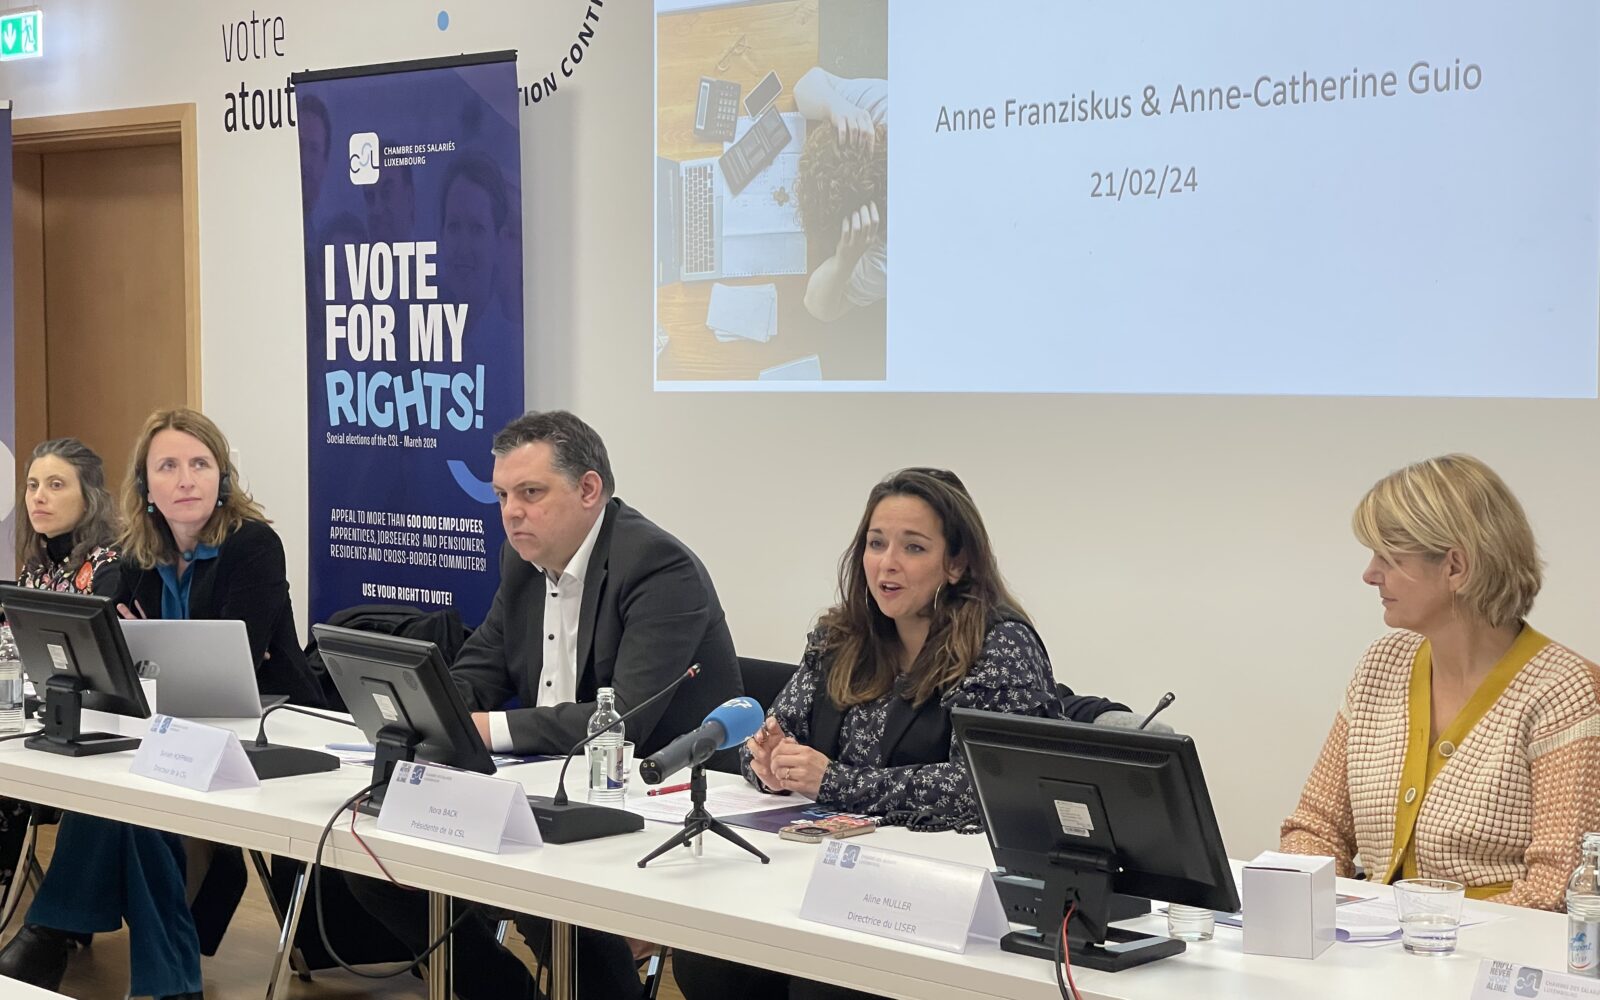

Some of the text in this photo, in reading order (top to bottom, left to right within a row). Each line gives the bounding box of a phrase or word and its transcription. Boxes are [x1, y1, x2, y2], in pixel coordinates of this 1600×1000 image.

[222, 10, 285, 62] votre
[518, 72, 557, 106] ION
[935, 57, 1482, 133] Anne Franziskus & Anne-Catherine Guio
[224, 77, 295, 132] atout
[384, 140, 456, 156] CHAMBRE DES SALARIÉS
[384, 156, 426, 166] LUXEMBOURG
[1089, 165, 1198, 201] 21/02/24
[324, 241, 438, 300] I VOTE
[326, 304, 468, 362] FOR MY
[326, 364, 485, 432] RIGHTS!
[326, 432, 344, 444] Social
[346, 434, 370, 446] elections
[371, 434, 377, 446] of
[377, 434, 386, 446] the
[388, 434, 398, 447] CSL
[404, 435, 422, 448] March
[423, 438, 437, 448] 2024
[331, 508, 484, 535] APPEAL TO MORE THAN 600 000 EMPLOYEES,
[330, 526, 486, 554] APPRENTICES, JOBSEEKERS AND PENSIONERS,
[330, 544, 486, 572] RESIDENTS AND CROSS-BORDER COMMUTERS!
[362, 583, 452, 606] USE YOUR RIGHT TO VOTE!
[428, 806, 457, 817] Nora BACK
[863, 893, 912, 911] Aline MULLER
[847, 911, 917, 934] Directrice du LISER
